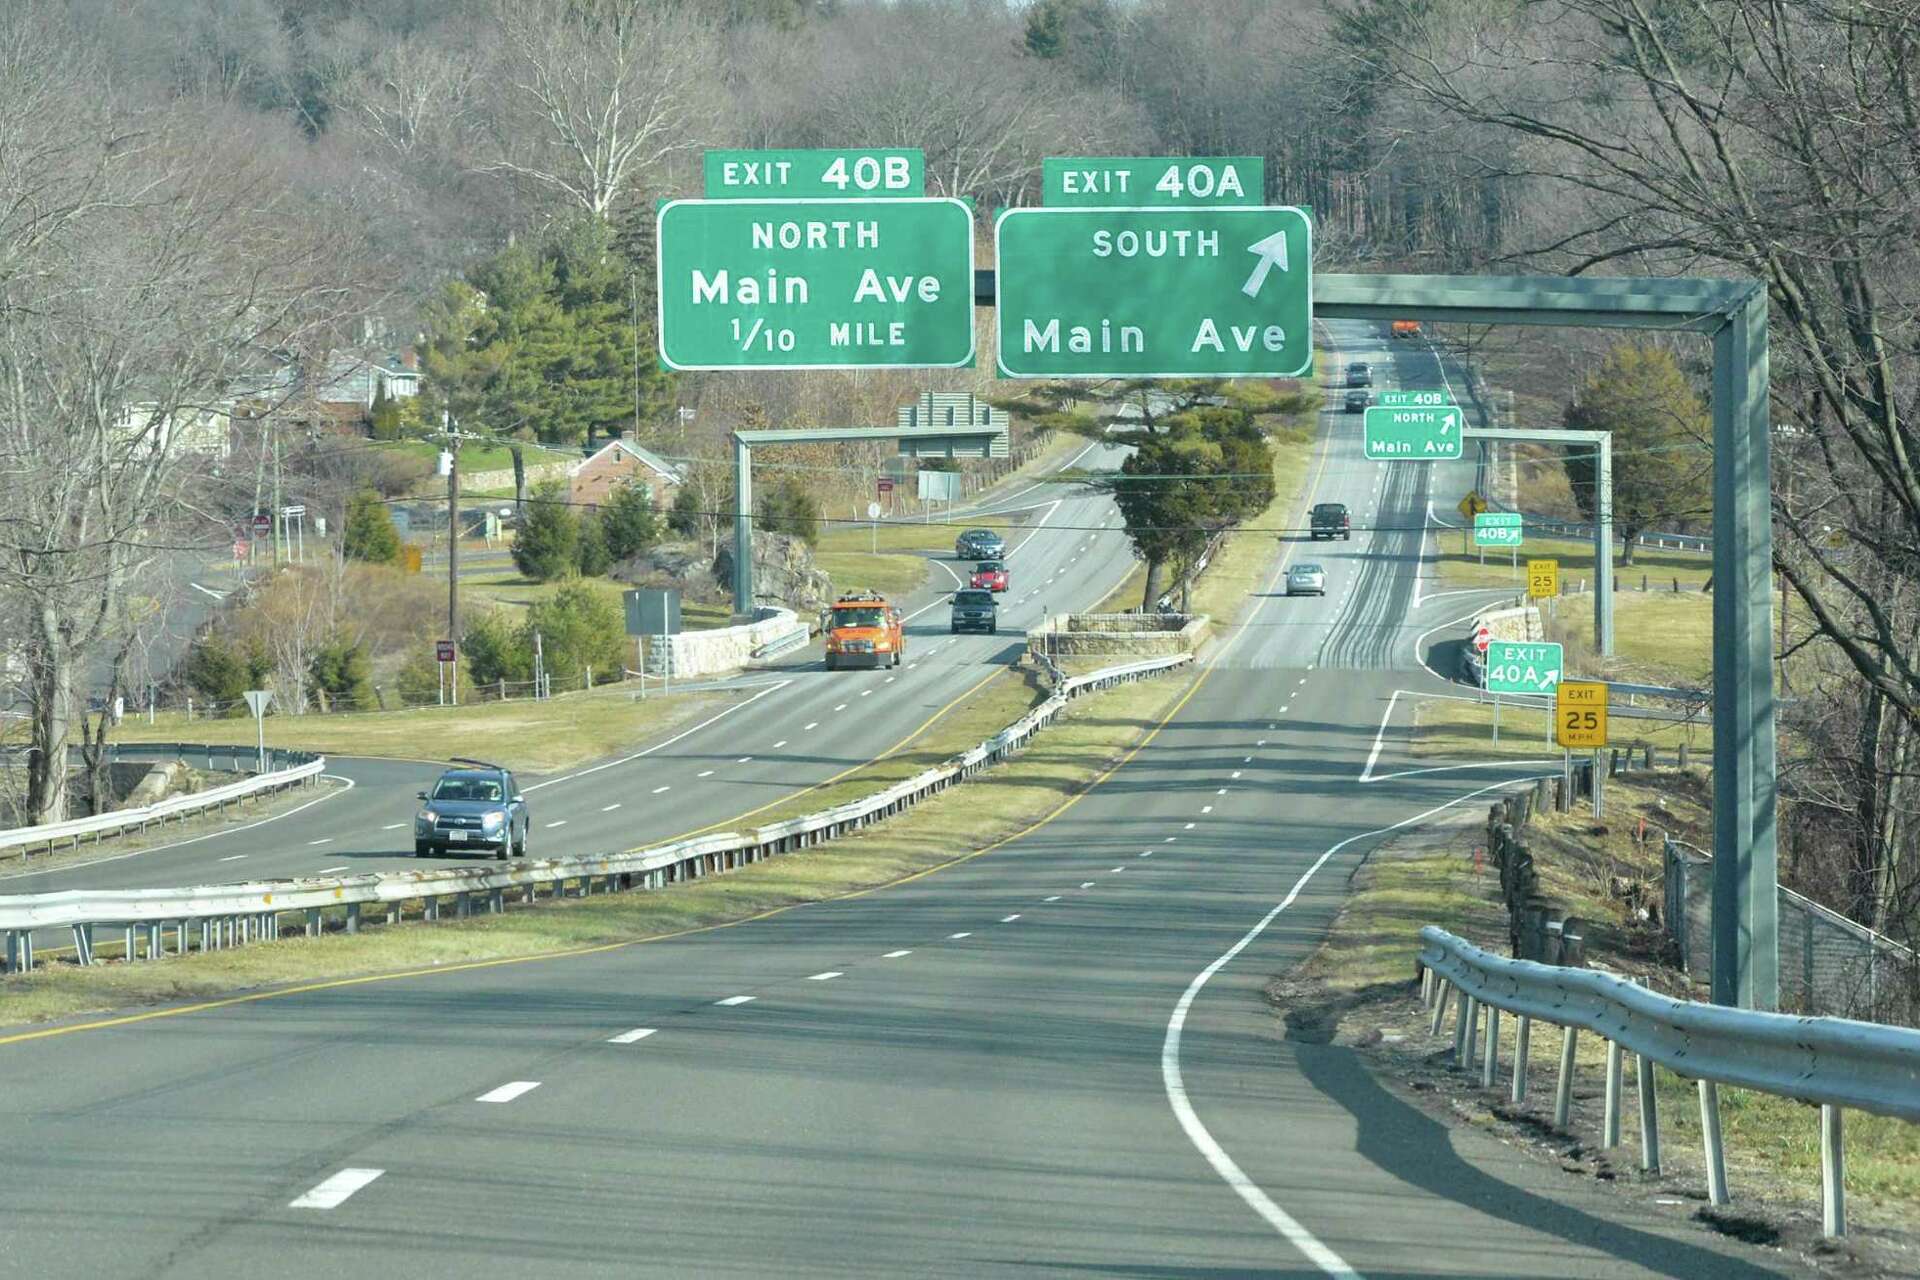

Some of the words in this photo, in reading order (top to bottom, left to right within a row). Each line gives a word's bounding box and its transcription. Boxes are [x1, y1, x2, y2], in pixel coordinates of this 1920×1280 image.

[723, 161, 792, 186] EXIT
[821, 156, 911, 190] 40B
[1063, 170, 1131, 194] EXIT
[1155, 164, 1245, 198] 40A
[751, 221, 880, 249] NORTH
[1092, 230, 1219, 257] SOUTH
[692, 268, 808, 305] Main
[853, 267, 941, 304] Ave
[731, 317, 796, 352] 1/10
[830, 322, 905, 346] MILE
[1024, 318, 1144, 353] Main
[1191, 318, 1286, 353] Ave
[1384, 394, 1407, 404] EXIT
[1413, 393, 1442, 405] 40B
[1393, 412, 1435, 423] NORTH
[1372, 440, 1411, 453] Main
[1424, 440, 1455, 453] Ave
[1485, 517, 1513, 526] EXIT
[1478, 528, 1507, 539] 40B
[1533, 576, 1552, 587] 25
[1504, 647, 1547, 661] EXIT
[1490, 664, 1539, 683] 40A
[1568, 689, 1595, 700] EXIT
[1566, 711, 1598, 730] 25
[1568, 733, 1593, 743] MPH
